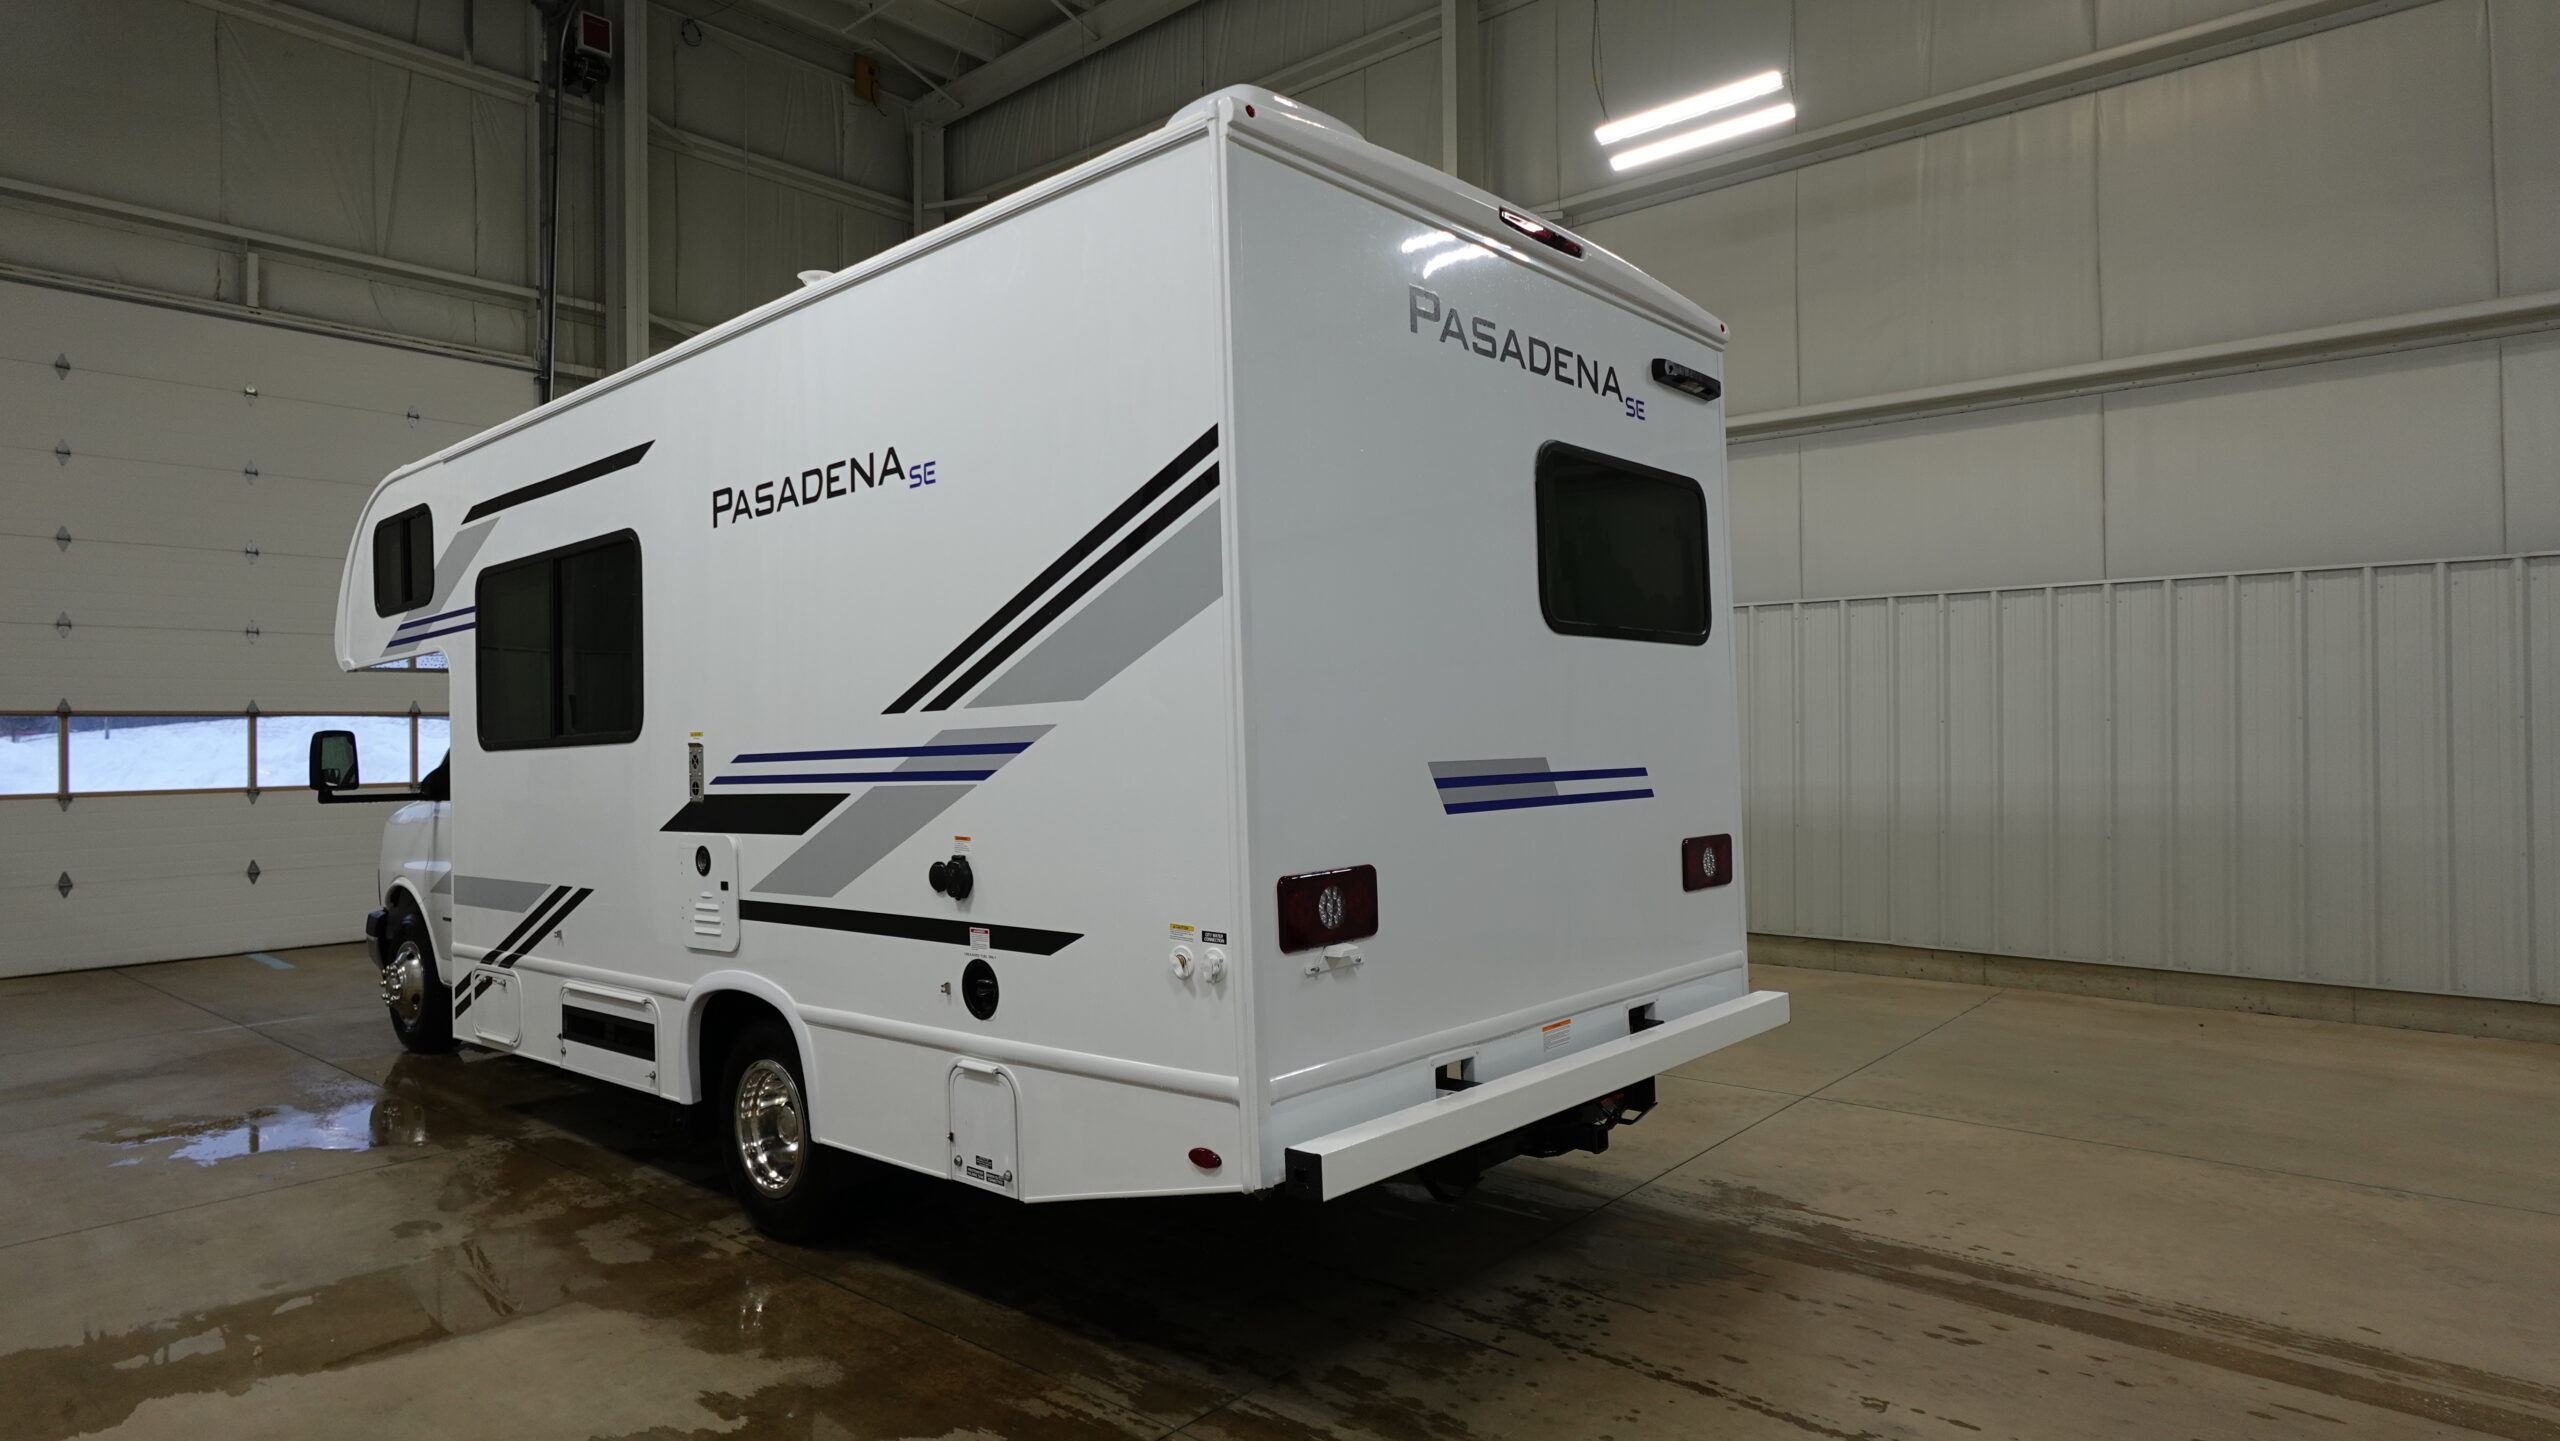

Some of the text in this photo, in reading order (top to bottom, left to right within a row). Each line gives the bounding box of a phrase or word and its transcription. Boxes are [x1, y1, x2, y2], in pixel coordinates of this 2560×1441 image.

[1409, 283, 1646, 421] PASADENA SE
[712, 446, 936, 529] PASADENA SE
